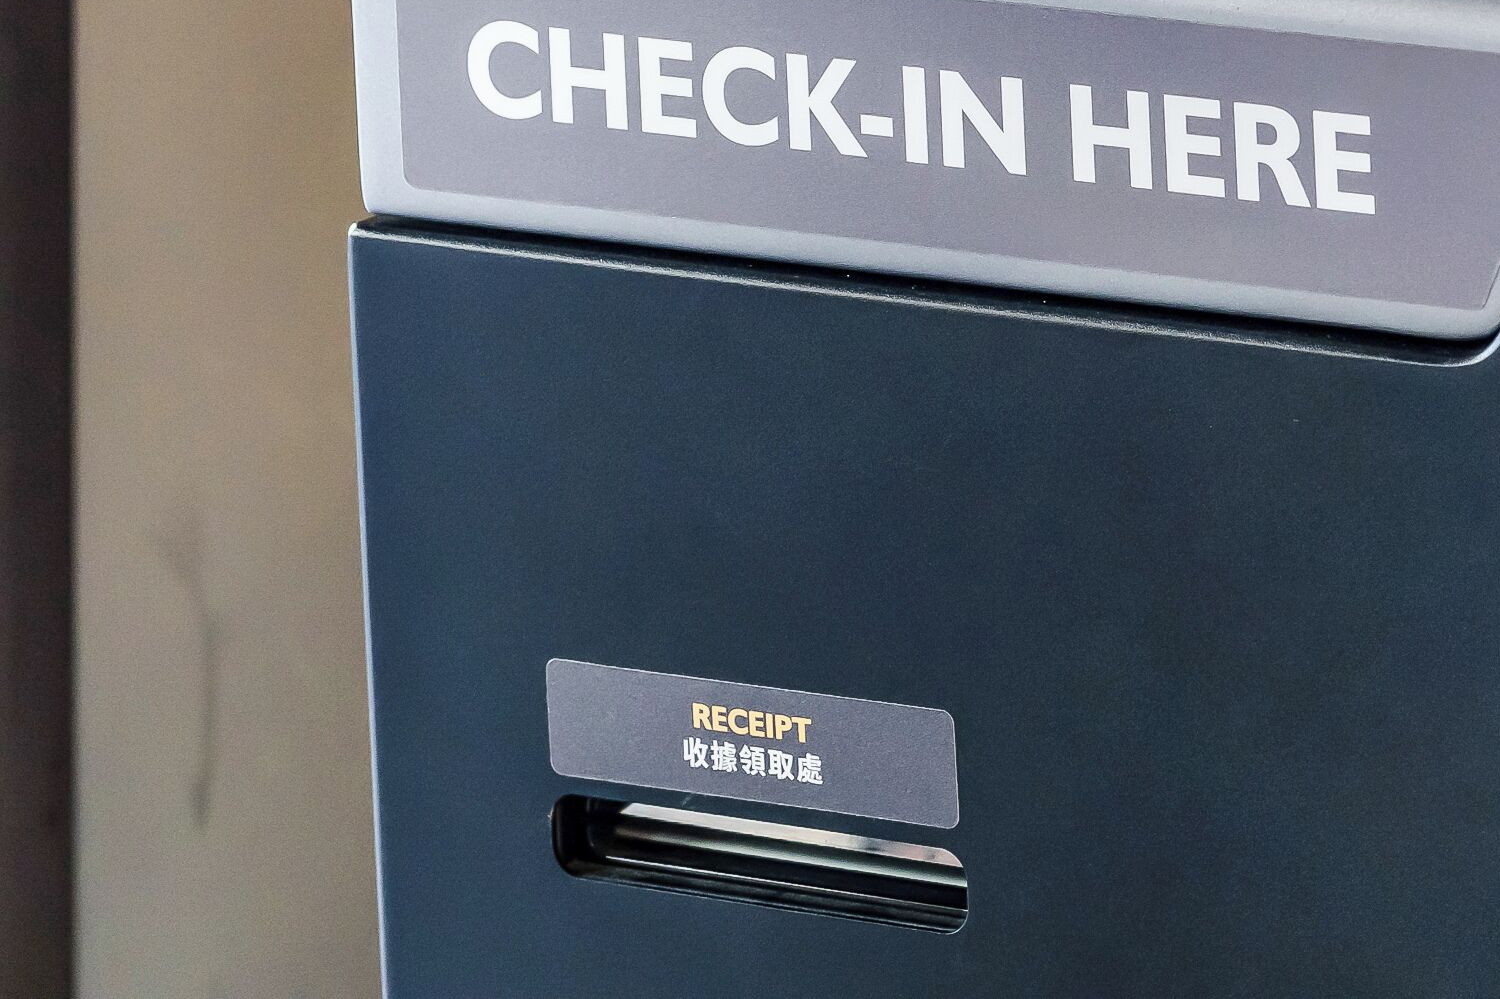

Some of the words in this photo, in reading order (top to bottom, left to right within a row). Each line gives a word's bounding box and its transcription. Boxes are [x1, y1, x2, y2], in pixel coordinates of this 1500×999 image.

[466, 19, 1028, 176] CHECK-IN
[1069, 83, 1377, 216] HERE
[691, 702, 813, 744] RECEIPT
[682, 737, 824, 786] 收據領取處
